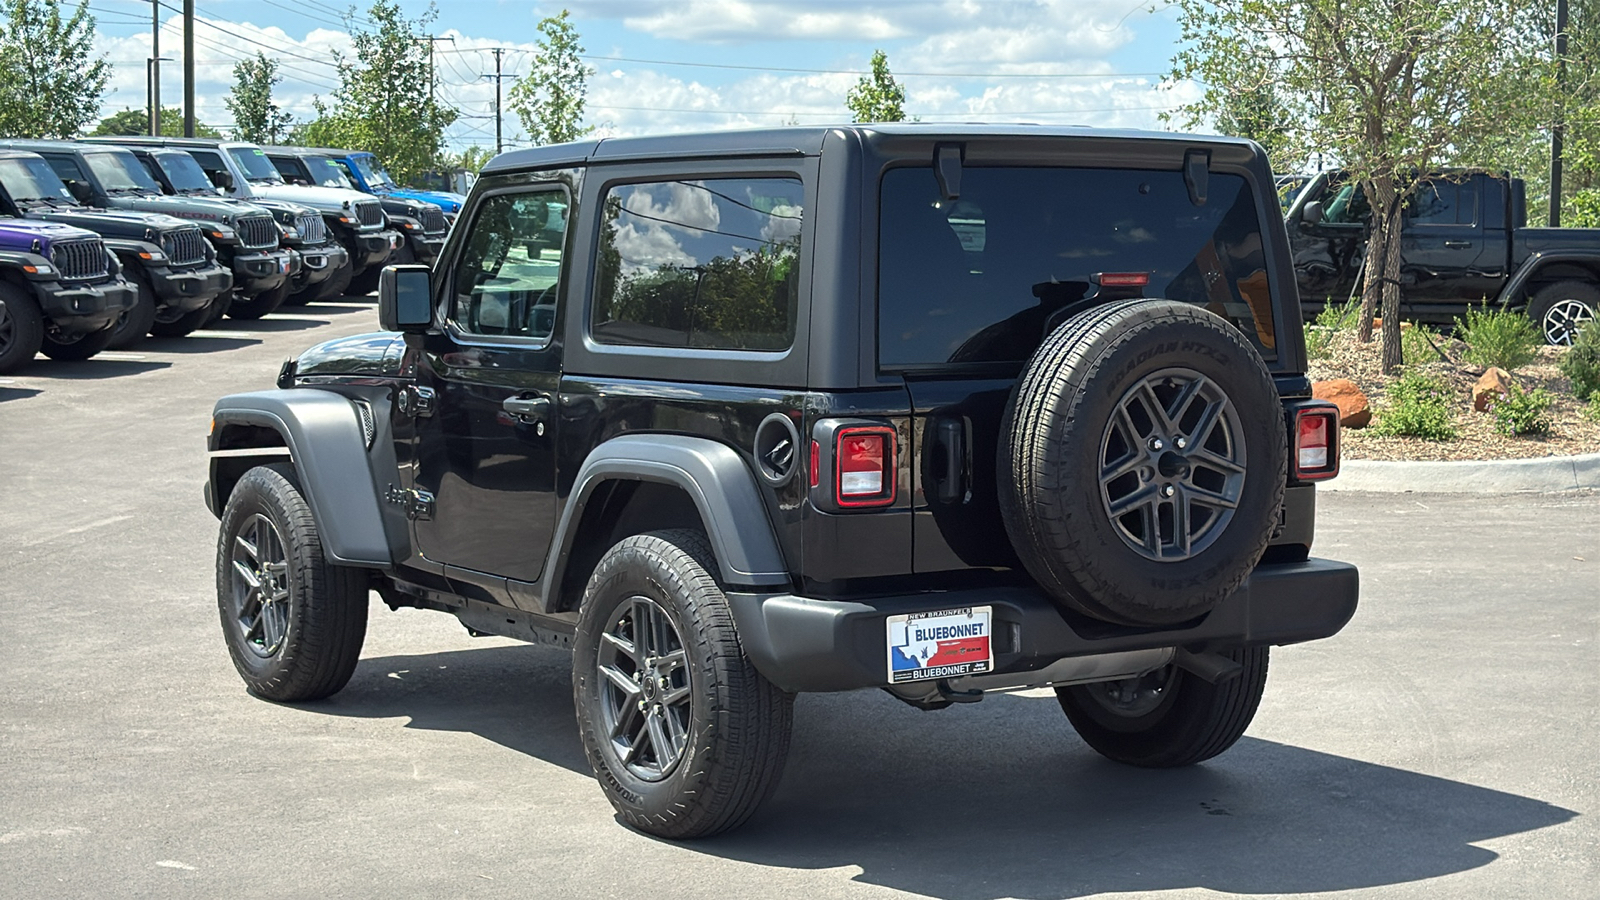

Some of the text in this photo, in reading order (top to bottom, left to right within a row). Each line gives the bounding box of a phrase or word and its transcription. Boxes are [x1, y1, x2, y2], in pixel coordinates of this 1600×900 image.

[1107, 341, 1179, 396] ROADIAN
[928, 609, 971, 618] BRAUNFELS
[916, 623, 984, 642] BLUEBONNET
[913, 664, 970, 679] BLUEBONNET
[594, 748, 638, 803] ROADIAN
